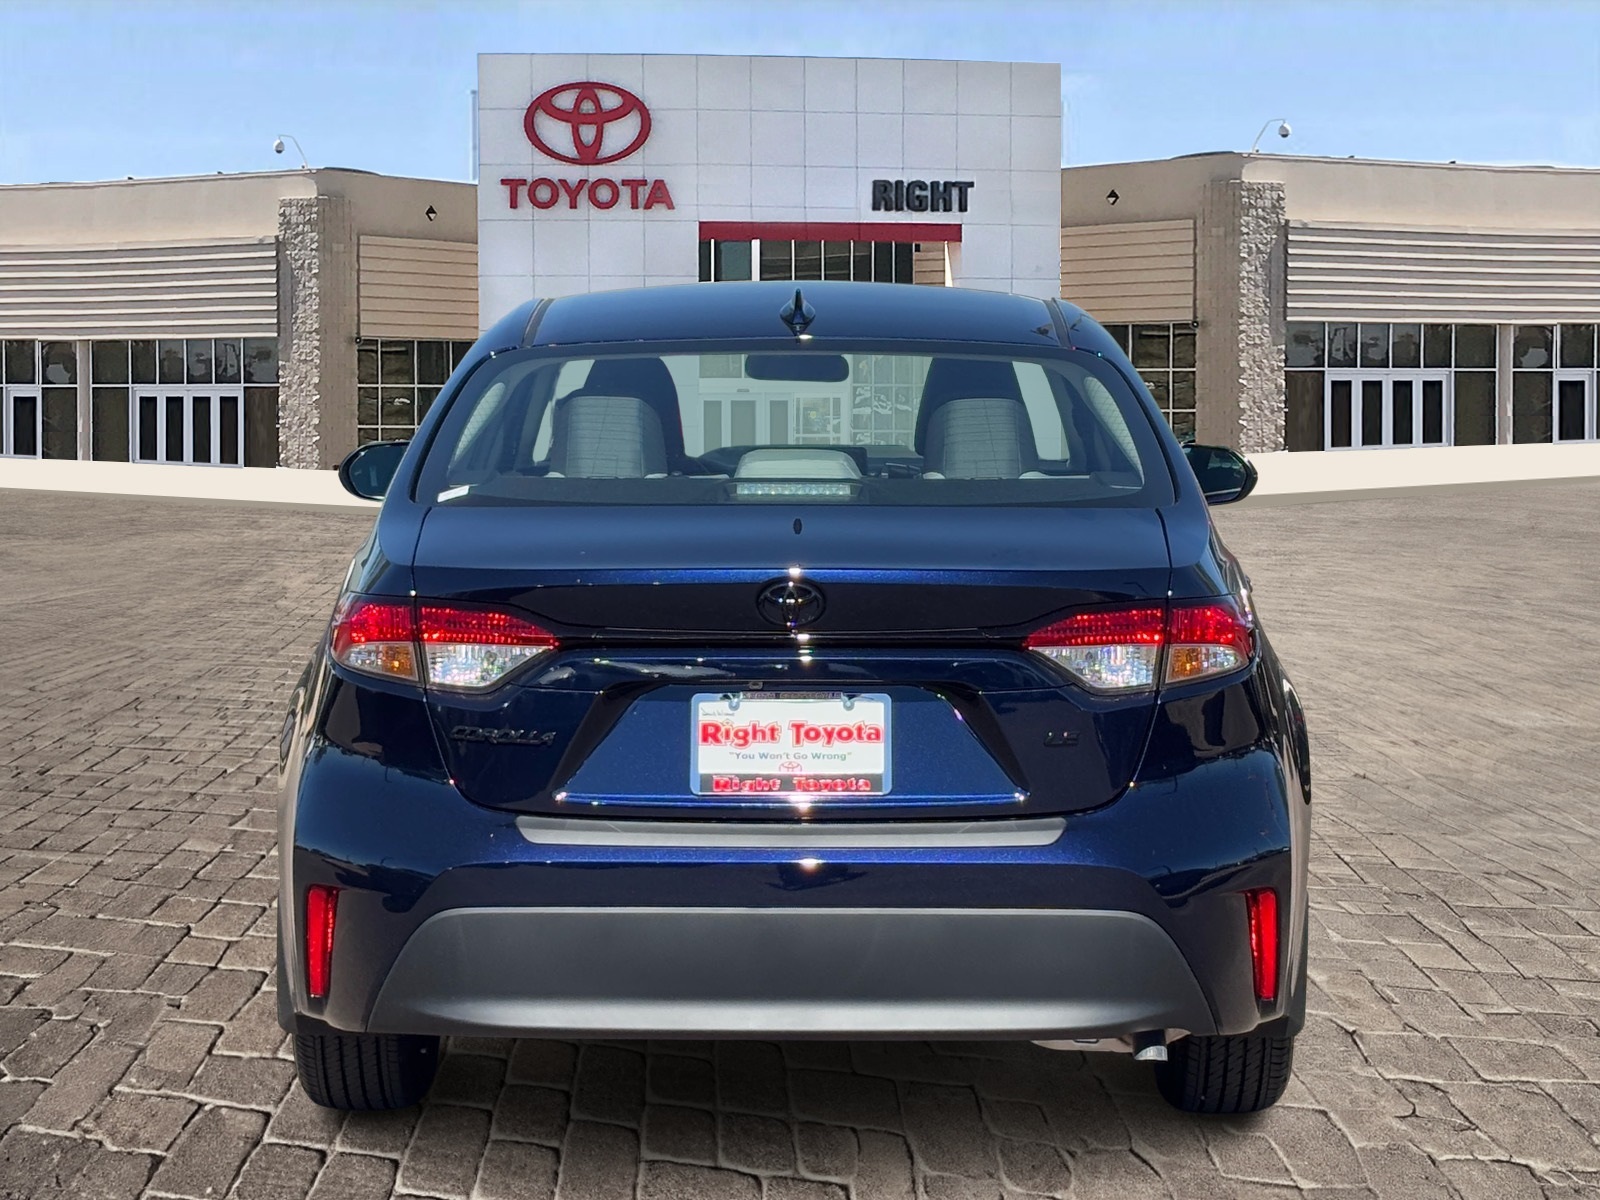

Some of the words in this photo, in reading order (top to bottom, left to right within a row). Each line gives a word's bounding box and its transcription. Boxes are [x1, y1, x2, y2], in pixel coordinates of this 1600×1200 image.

[500, 178, 675, 210] TOYOTA
[871, 178, 975, 213] RIGHT
[699, 720, 781, 749] Right
[789, 720, 884, 747] Toyota
[757, 752, 790, 760] Won't
[793, 752, 808, 760] Go
[712, 775, 781, 792] Right
[792, 777, 872, 792] Toyota
